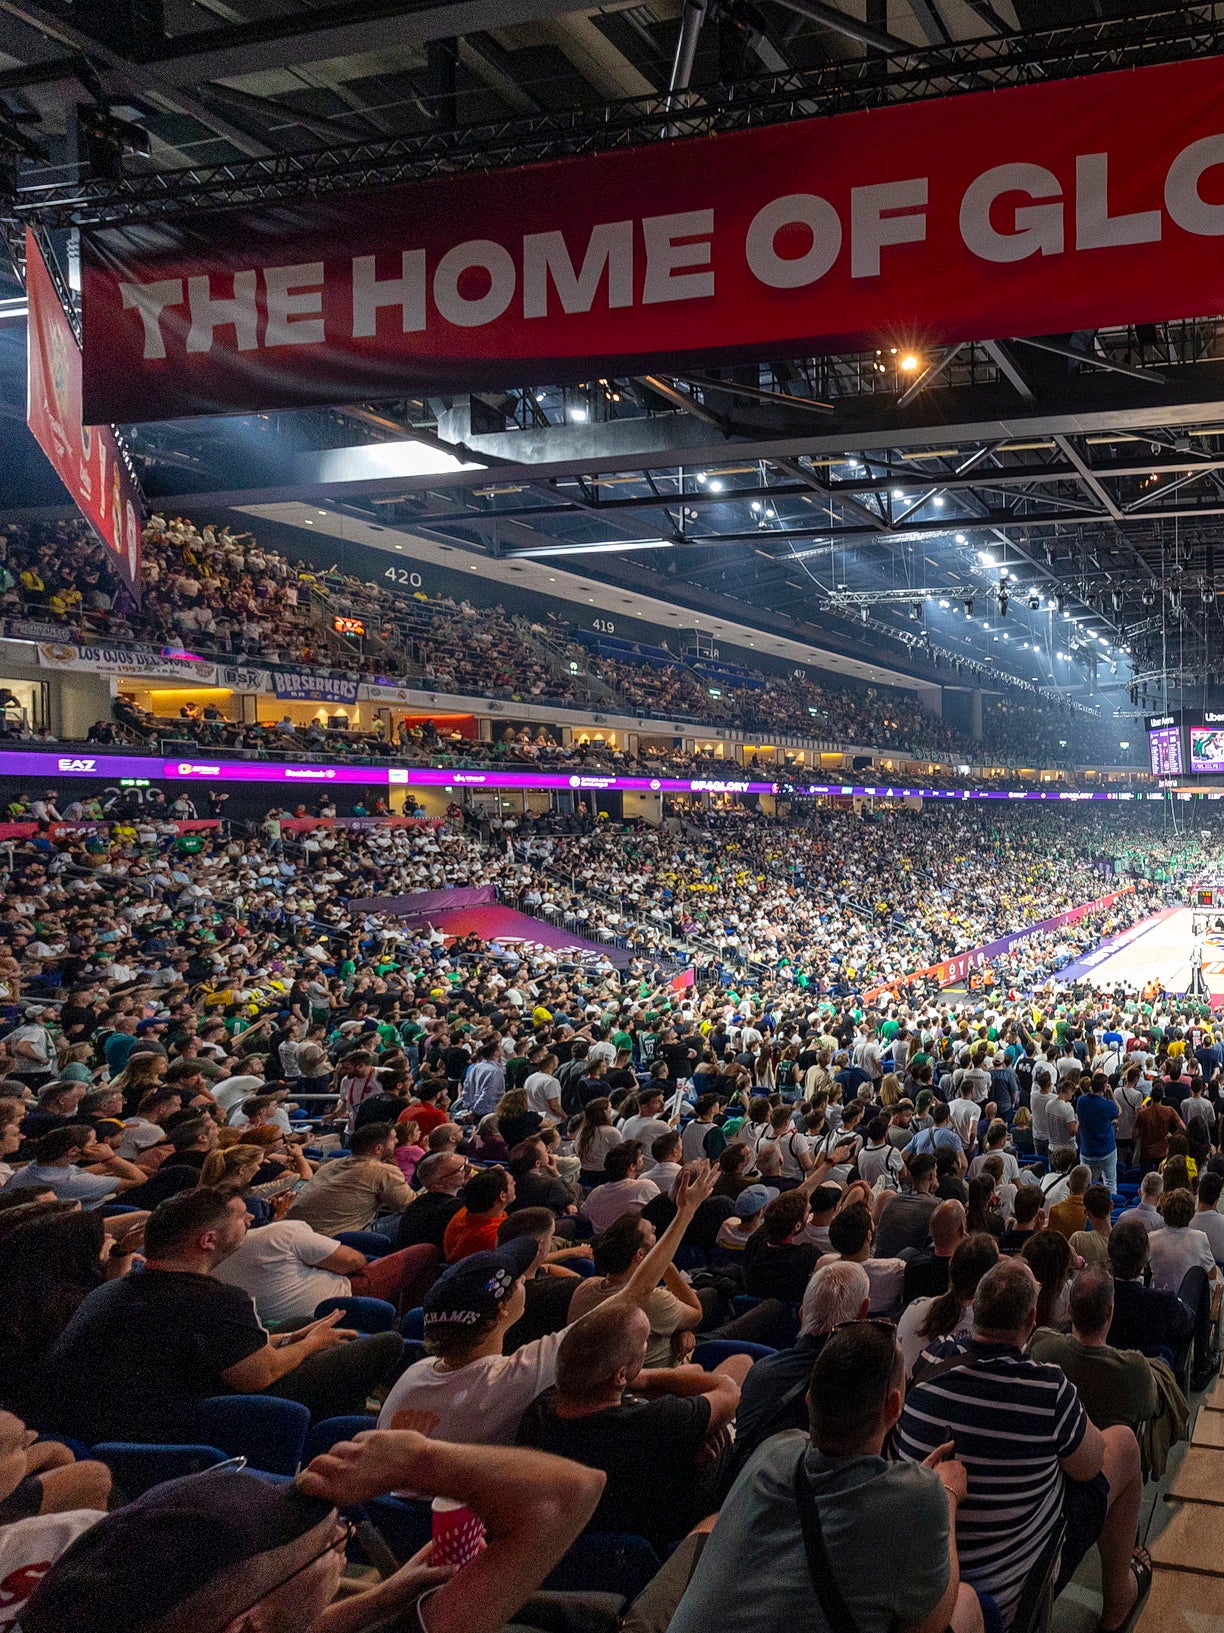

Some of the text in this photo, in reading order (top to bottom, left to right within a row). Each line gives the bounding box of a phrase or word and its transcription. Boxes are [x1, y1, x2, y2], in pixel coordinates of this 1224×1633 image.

[120, 262, 326, 360] THE
[352, 208, 715, 338] HOME
[746, 177, 929, 289] OF
[384, 566, 423, 588] 420
[592, 618, 615, 634] 419
[78, 647, 100, 662] LOS
[103, 650, 134, 665] OJOS
[273, 672, 356, 698] BERSERKERS
[58, 759, 96, 770] EA7
[691, 781, 749, 792] #F4GLORY
[424, 1310, 480, 1326] CHAMPS
